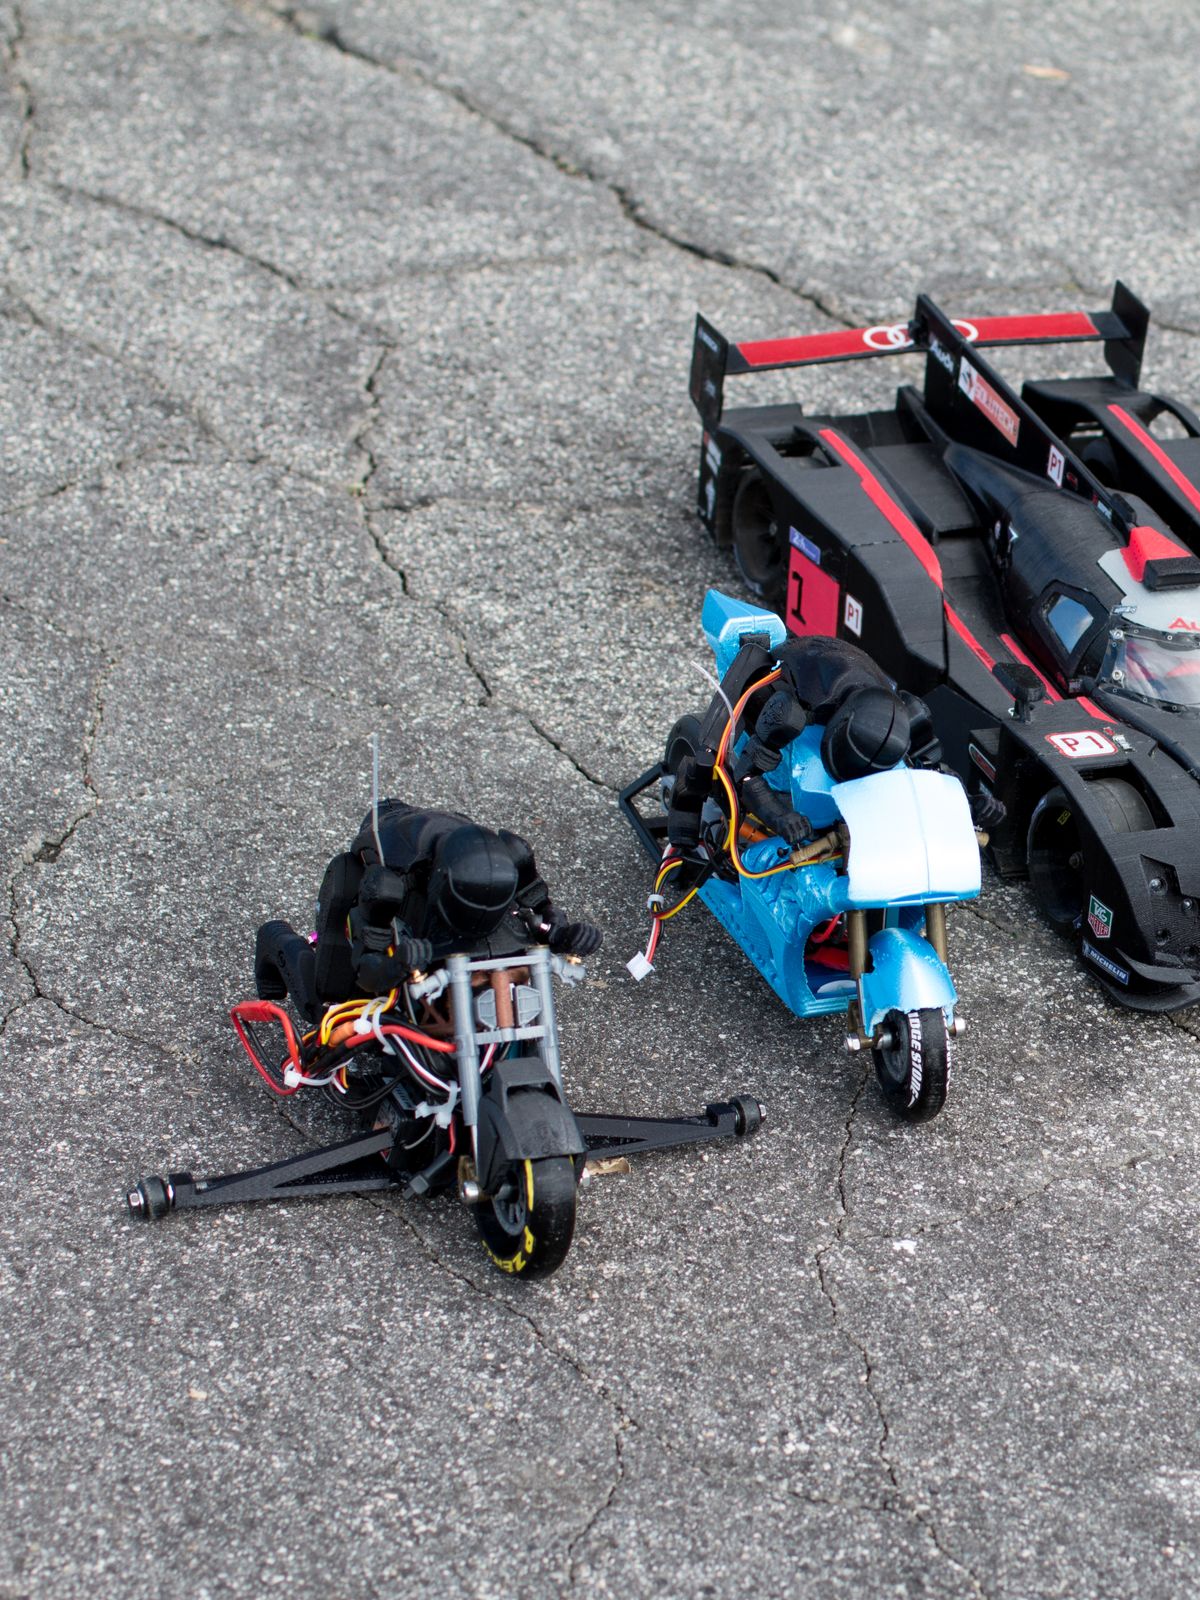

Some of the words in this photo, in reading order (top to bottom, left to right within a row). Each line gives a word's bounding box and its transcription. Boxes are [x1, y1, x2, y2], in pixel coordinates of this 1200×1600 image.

[1050, 454, 1063, 485] P1
[791, 570, 806, 626] 1
[847, 602, 860, 630] P1
[1089, 915, 1109, 935] HEUER
[1093, 902, 1108, 922] TAG
[1090, 950, 1127, 980] MICHELIN
